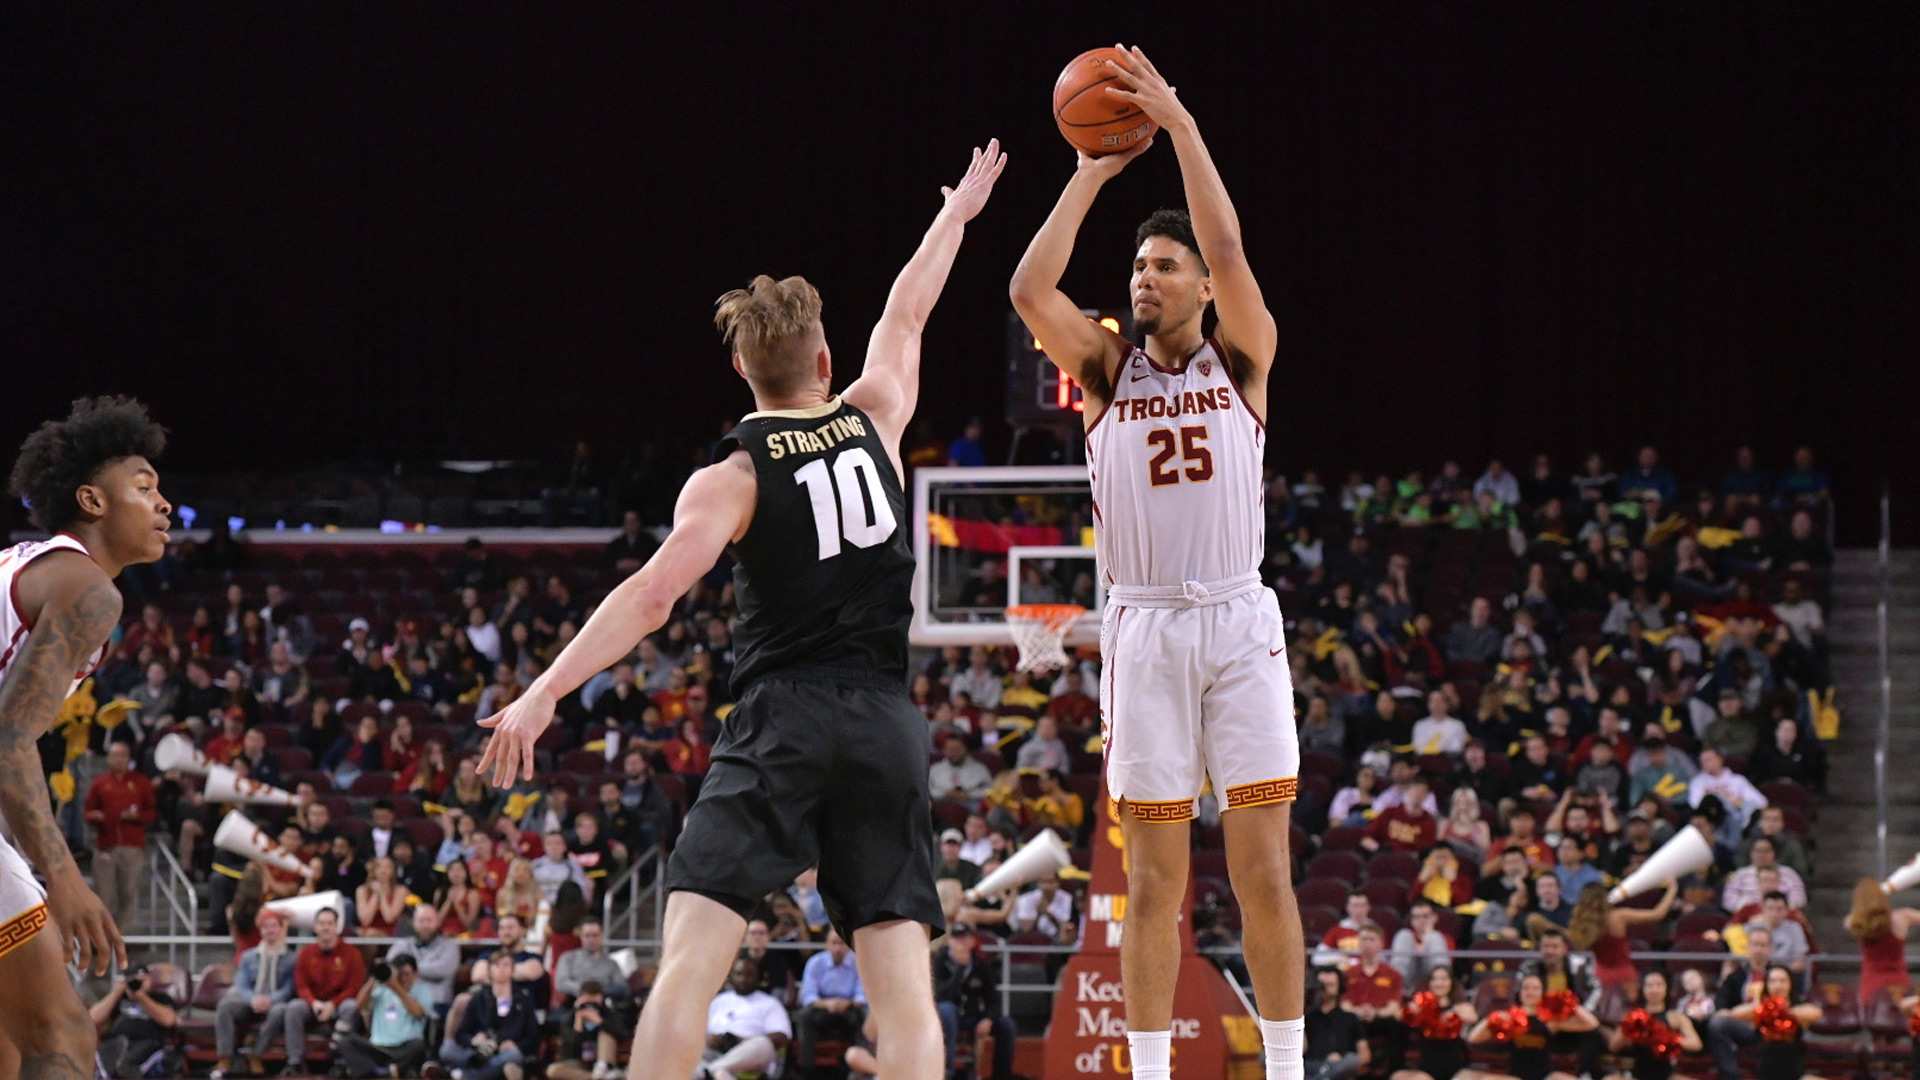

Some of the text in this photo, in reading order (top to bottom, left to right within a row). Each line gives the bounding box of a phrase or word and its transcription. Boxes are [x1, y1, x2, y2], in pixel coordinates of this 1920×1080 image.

[1114, 386, 1231, 423] TROJANS
[766, 415, 867, 460] STRATING
[1146, 425, 1214, 487] 25
[793, 447, 898, 561] 10
[1077, 971, 1125, 1002] Kec
[1076, 1007, 1200, 1039] Mene
[1075, 1043, 1109, 1073] of
